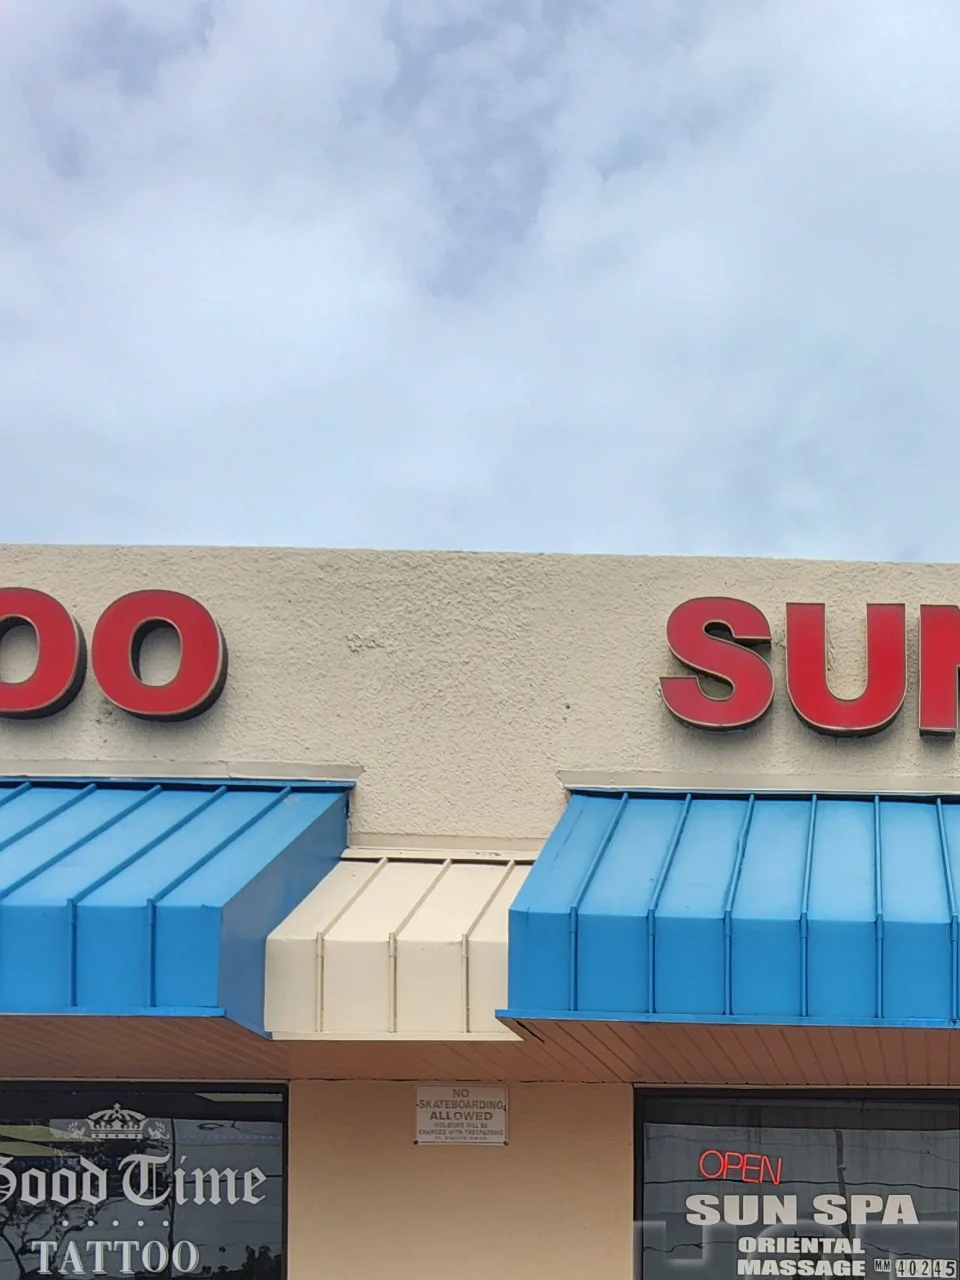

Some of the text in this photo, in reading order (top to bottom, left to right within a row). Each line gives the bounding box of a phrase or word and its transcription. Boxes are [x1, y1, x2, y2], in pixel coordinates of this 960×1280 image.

[452, 1088, 470, 1098] NO
[418, 1100, 504, 1109] SKATEBOARDING
[430, 1111, 493, 1120] ALLOWED
[699, 1149, 783, 1186] OPEN
[117, 1152, 268, 1206] Time
[685, 1194, 919, 1226] SUN SPA
[738, 1237, 866, 1254] ORIENTAL
[30, 1240, 200, 1275] TATTOO
[737, 1259, 956, 1276] MASSAGE MM 40245
